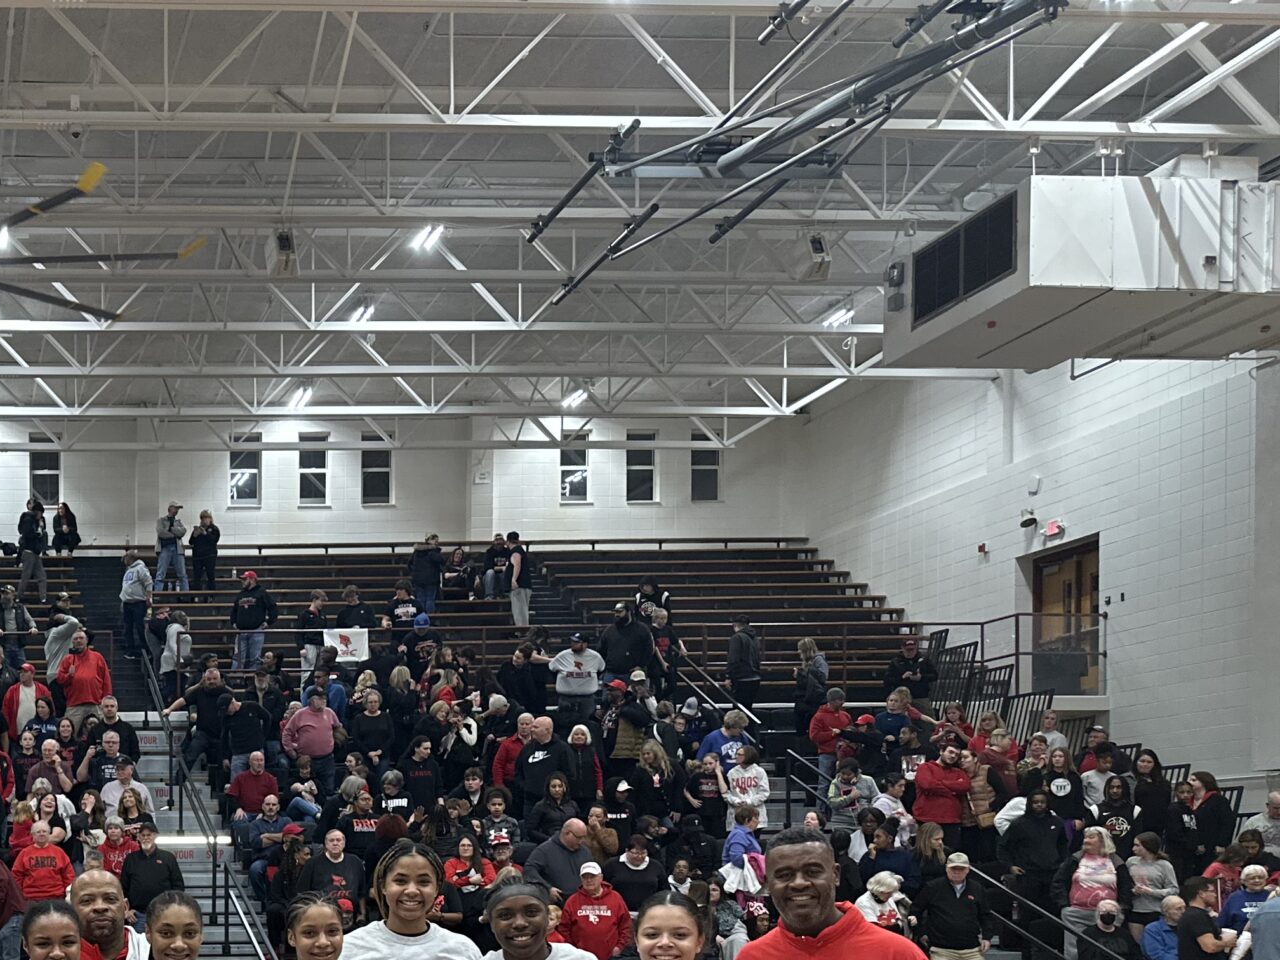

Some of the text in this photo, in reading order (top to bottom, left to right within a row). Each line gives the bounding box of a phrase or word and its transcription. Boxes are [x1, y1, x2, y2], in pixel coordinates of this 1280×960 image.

[140, 736, 158, 745] YOUR
[173, 849, 195, 860] YOUR
[577, 909, 612, 917] CARDINALS
